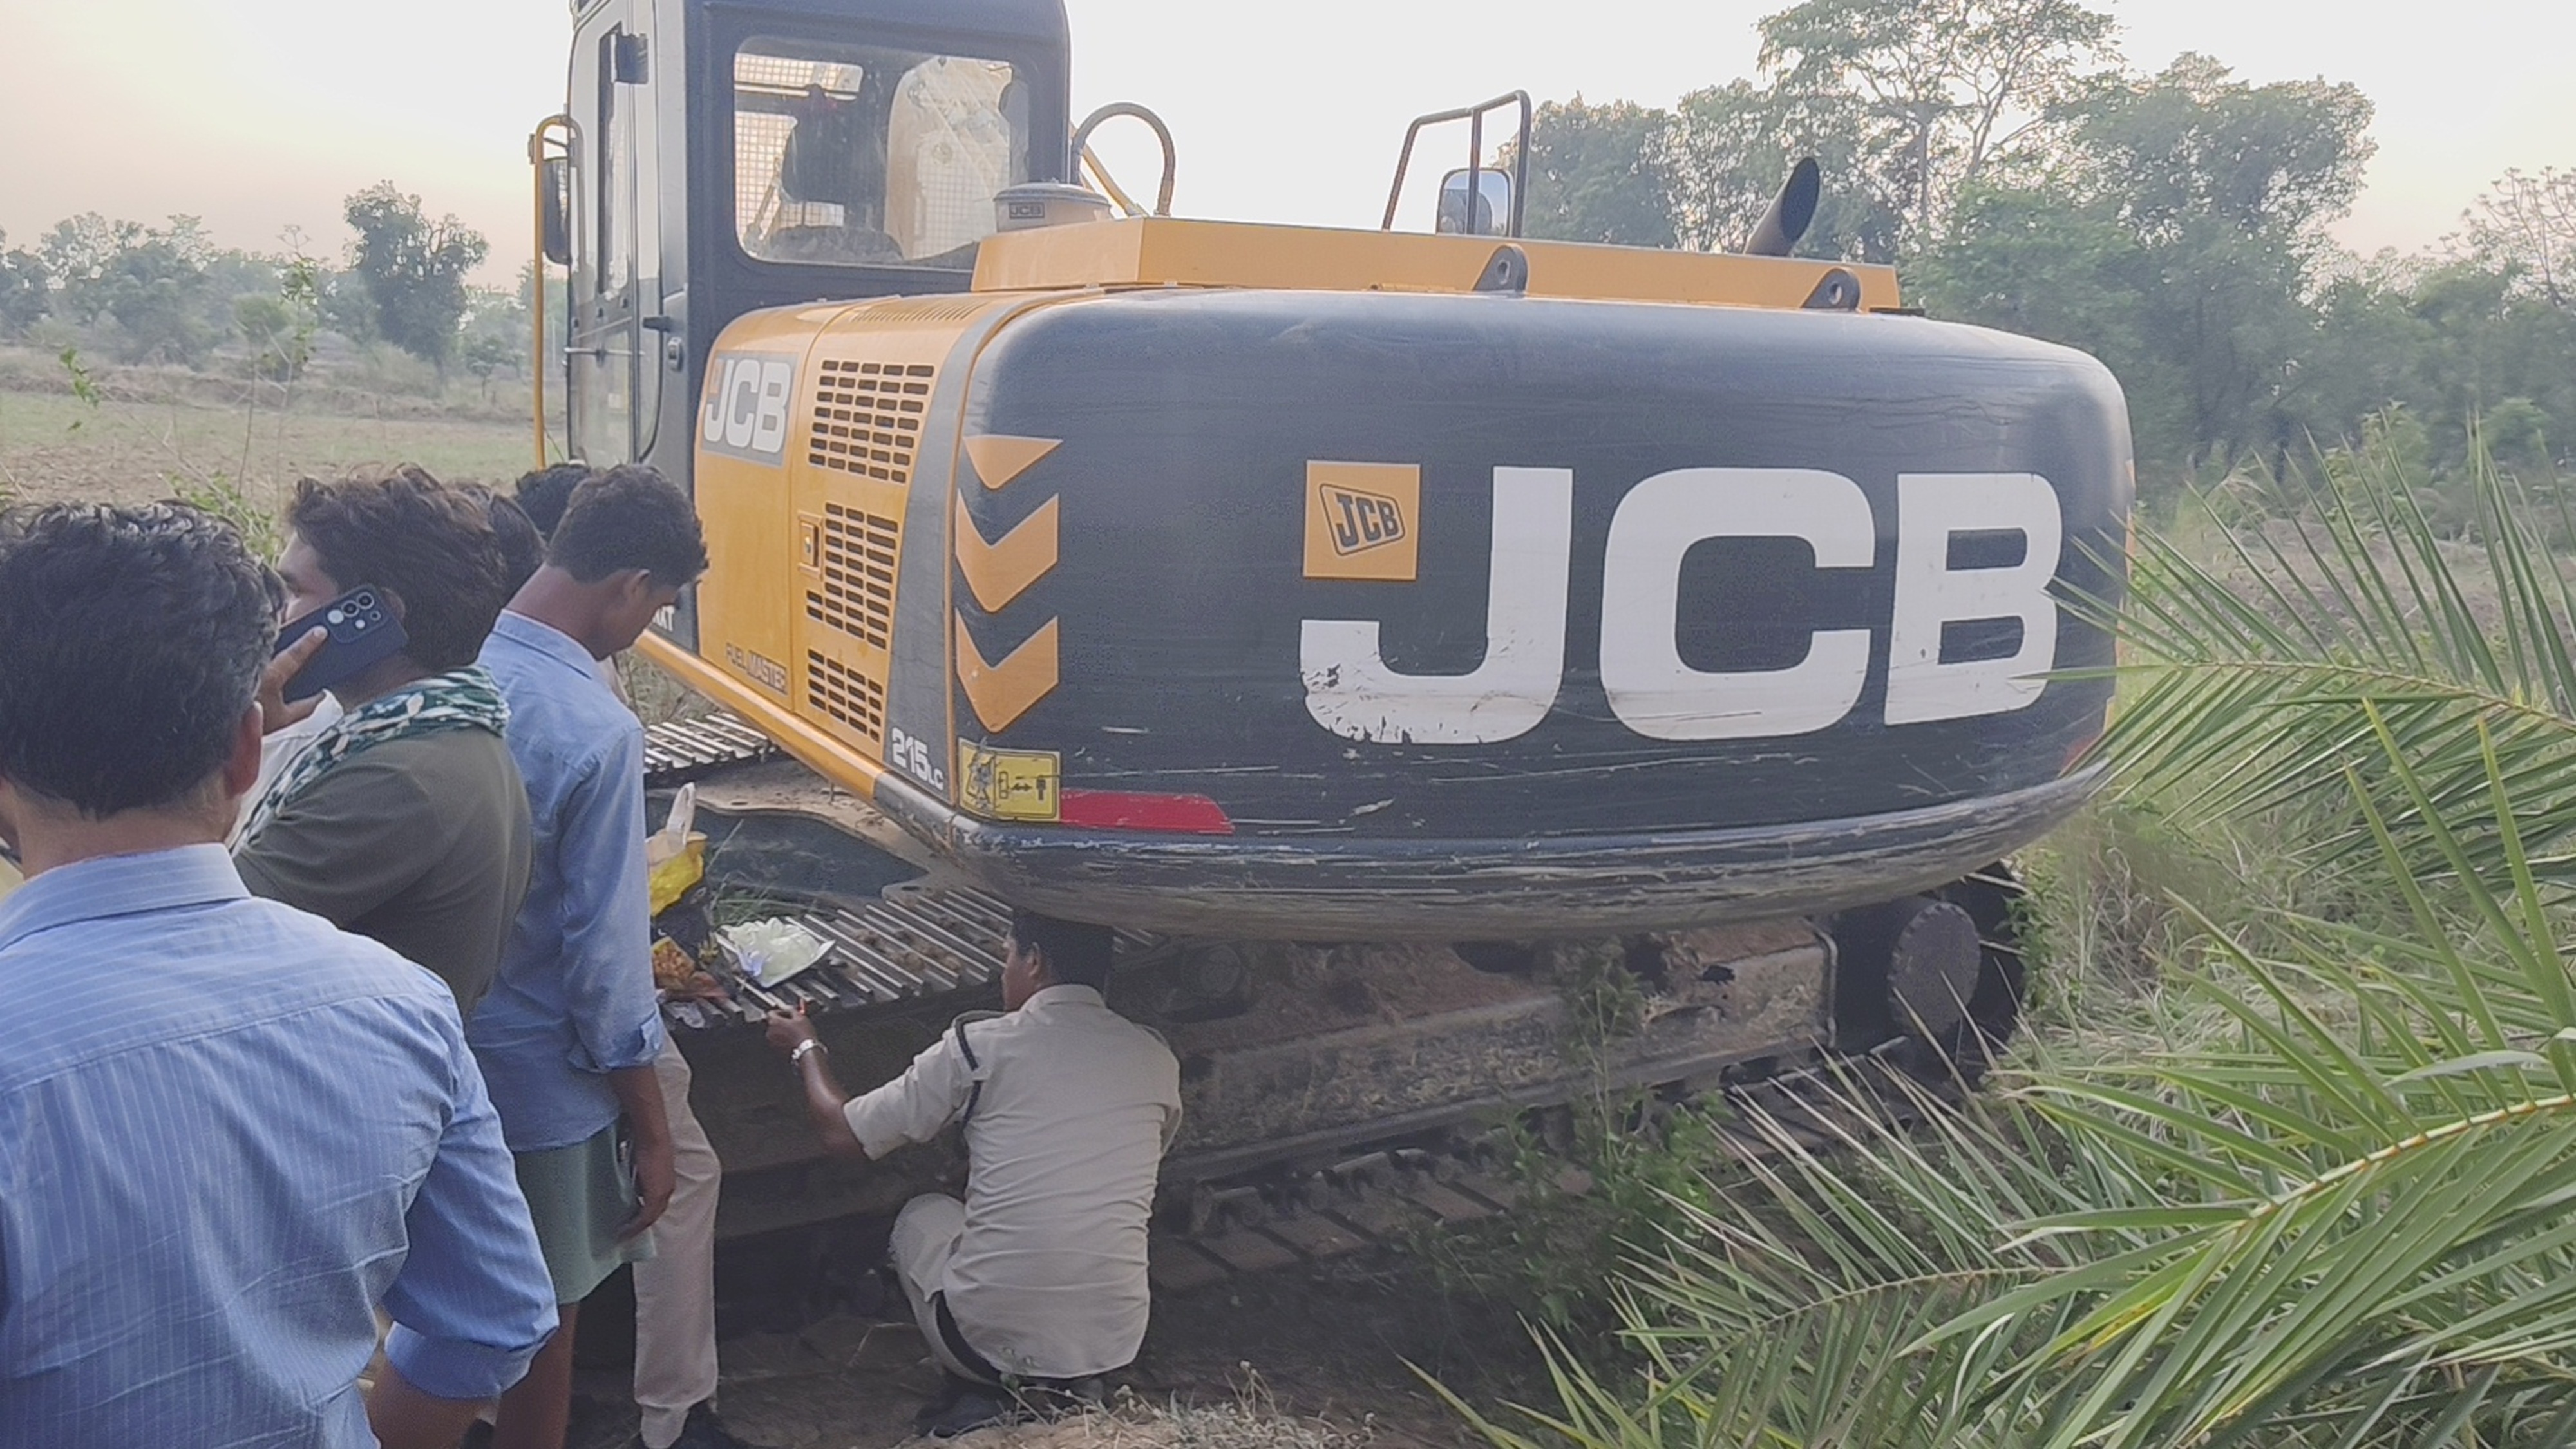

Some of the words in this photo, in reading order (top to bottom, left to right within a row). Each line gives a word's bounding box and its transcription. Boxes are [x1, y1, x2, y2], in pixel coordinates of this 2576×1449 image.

[1010, 205, 1041, 215] JCB
[704, 359, 791, 453] JCB
[1334, 492, 1399, 548] JCB
[1300, 466, 2062, 744] JCB
[726, 642, 747, 670] FUEL
[748, 651, 787, 694] MASTER
